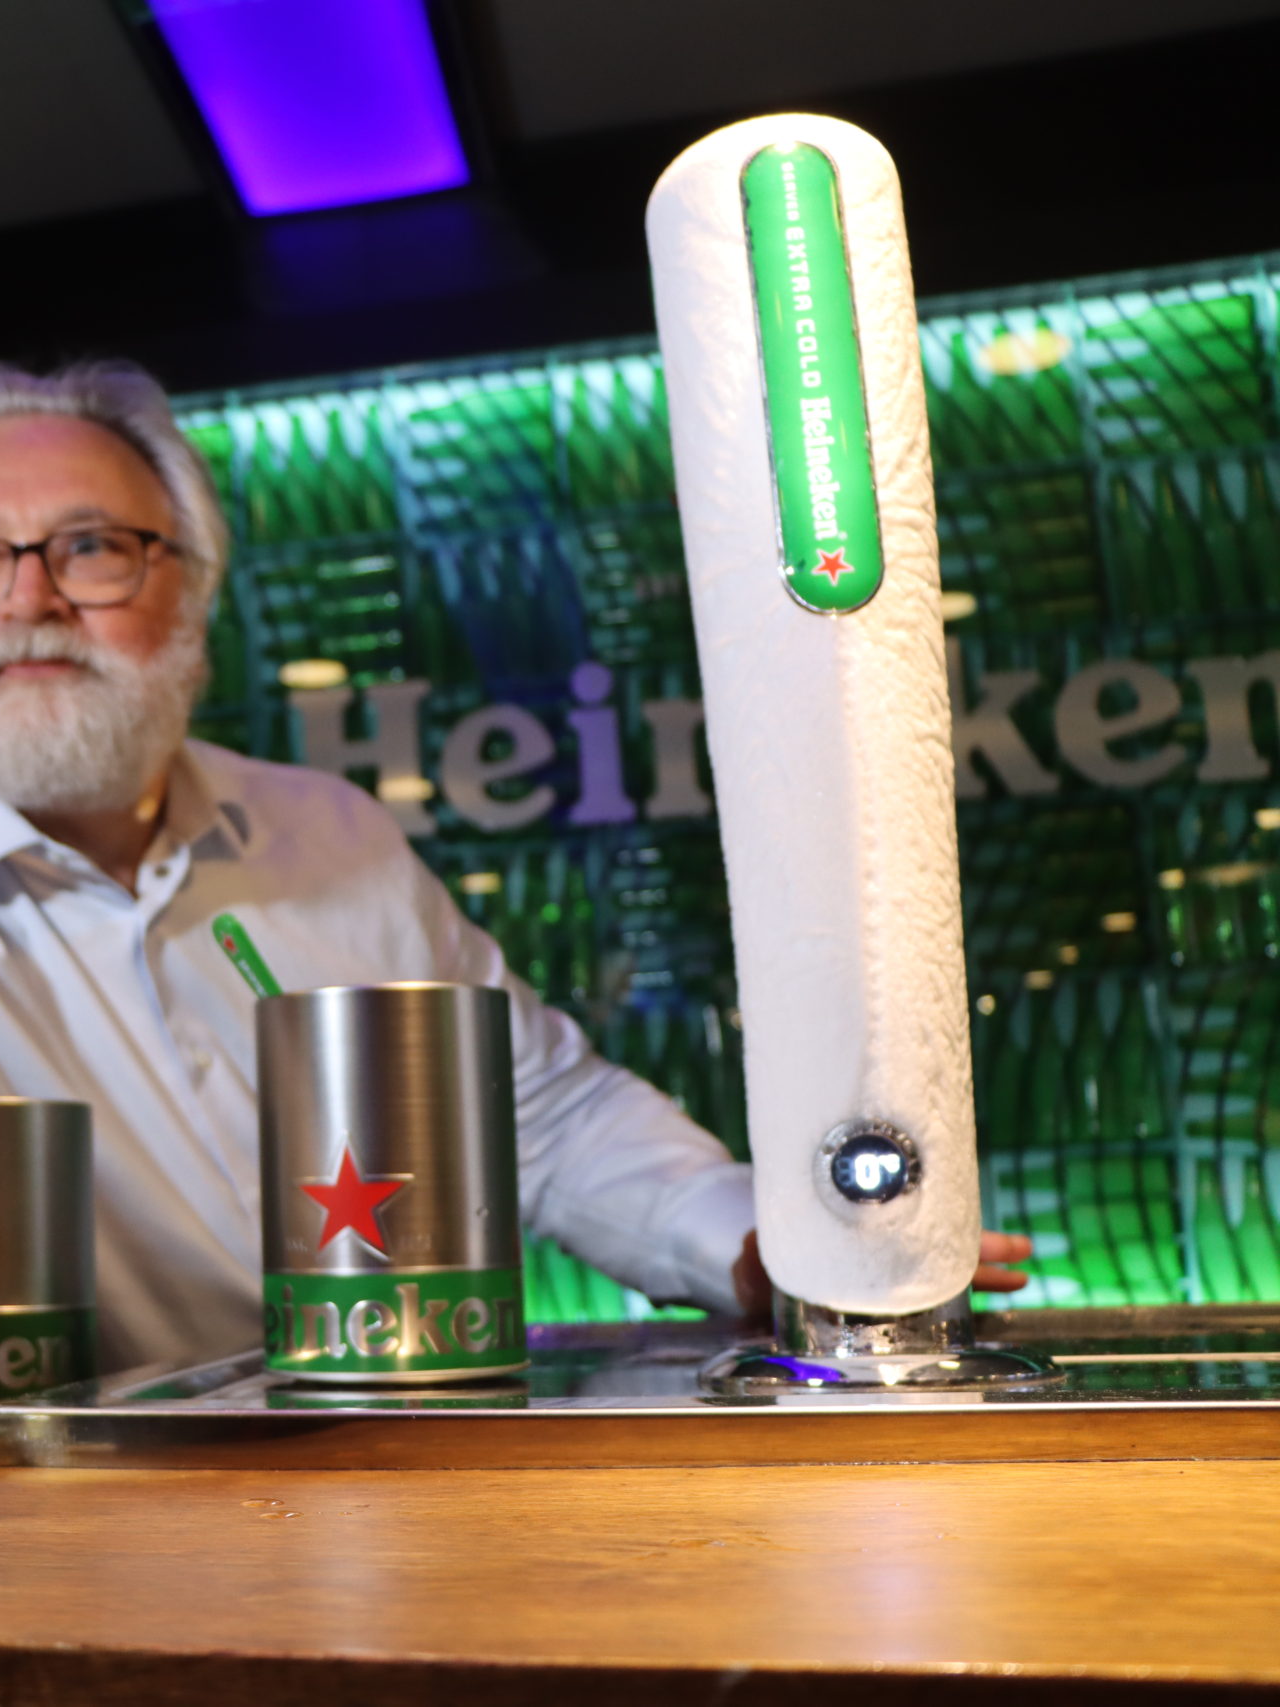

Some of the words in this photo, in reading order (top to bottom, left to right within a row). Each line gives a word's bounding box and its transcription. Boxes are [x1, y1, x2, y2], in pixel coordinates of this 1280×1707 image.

[784, 226, 813, 311] EXTRA
[795, 318, 822, 388] COLD
[800, 396, 841, 541] Heineken
[289, 637, 1280, 837] Heiken
